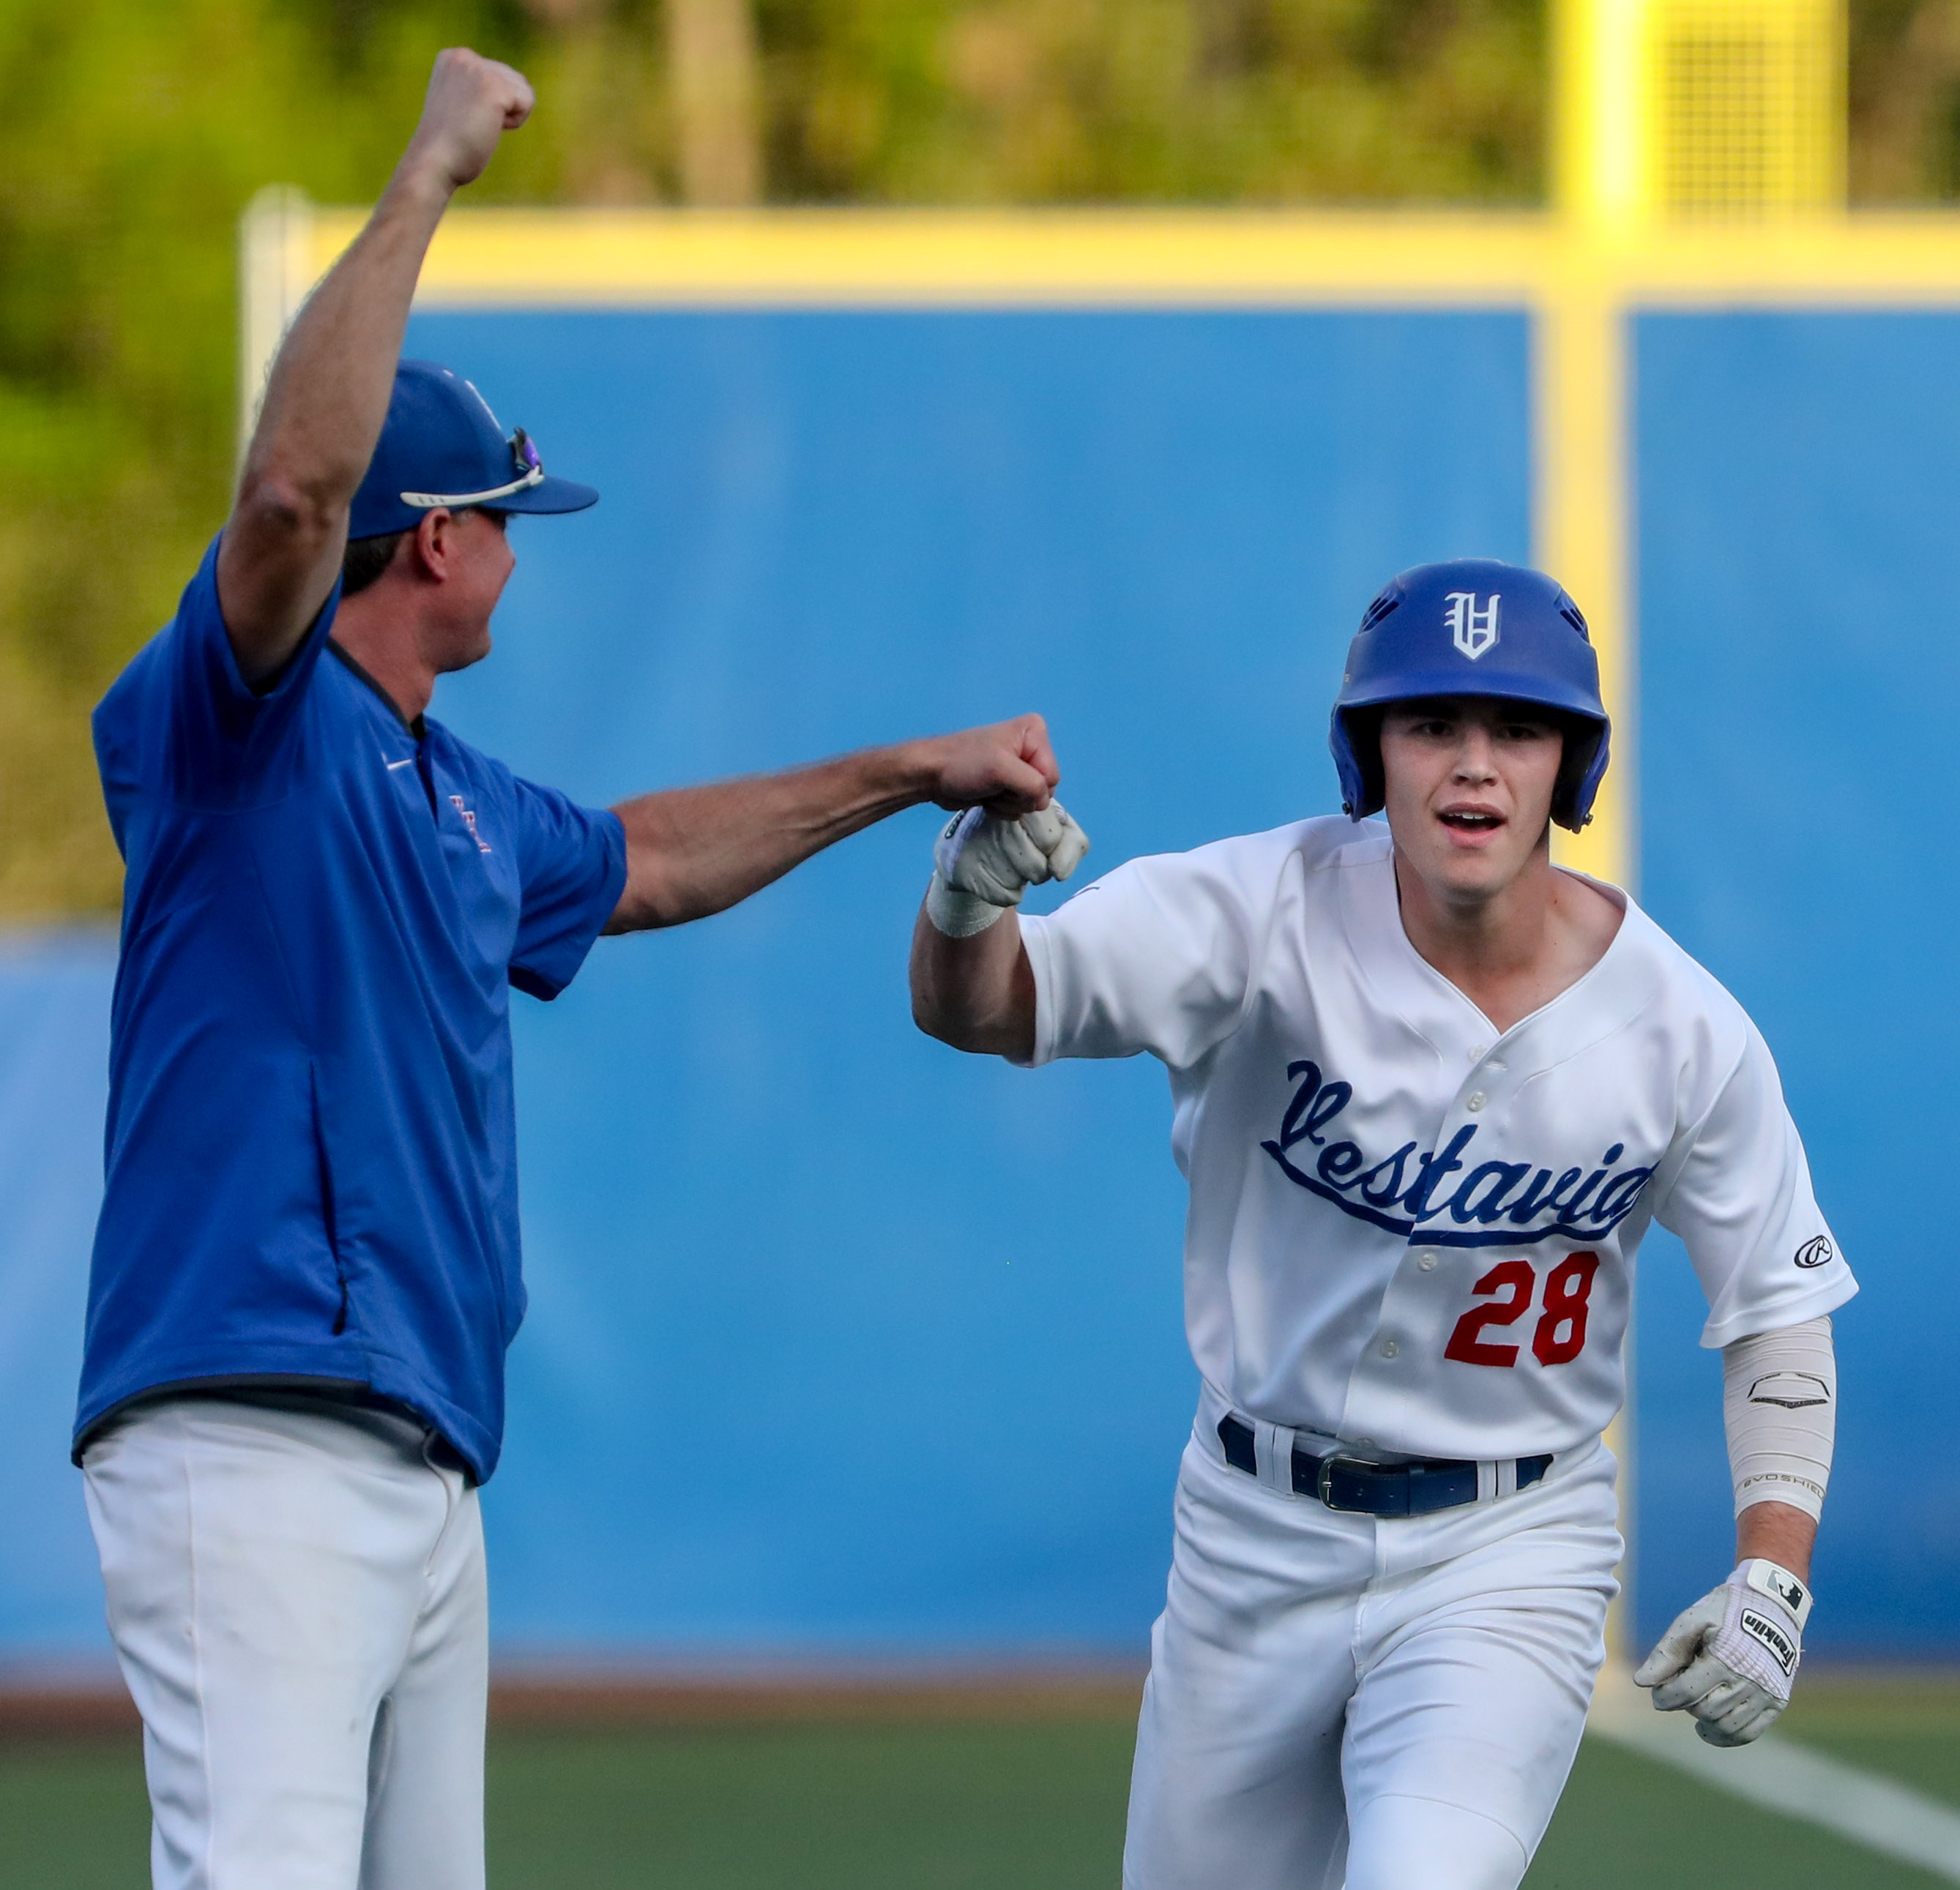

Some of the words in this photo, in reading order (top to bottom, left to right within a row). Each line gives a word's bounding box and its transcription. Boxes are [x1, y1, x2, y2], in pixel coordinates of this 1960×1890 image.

[1280, 1060, 1661, 1224] Vestavia
[1444, 1251, 1600, 1368] 28
[1744, 1615, 1795, 1667] Franklin
